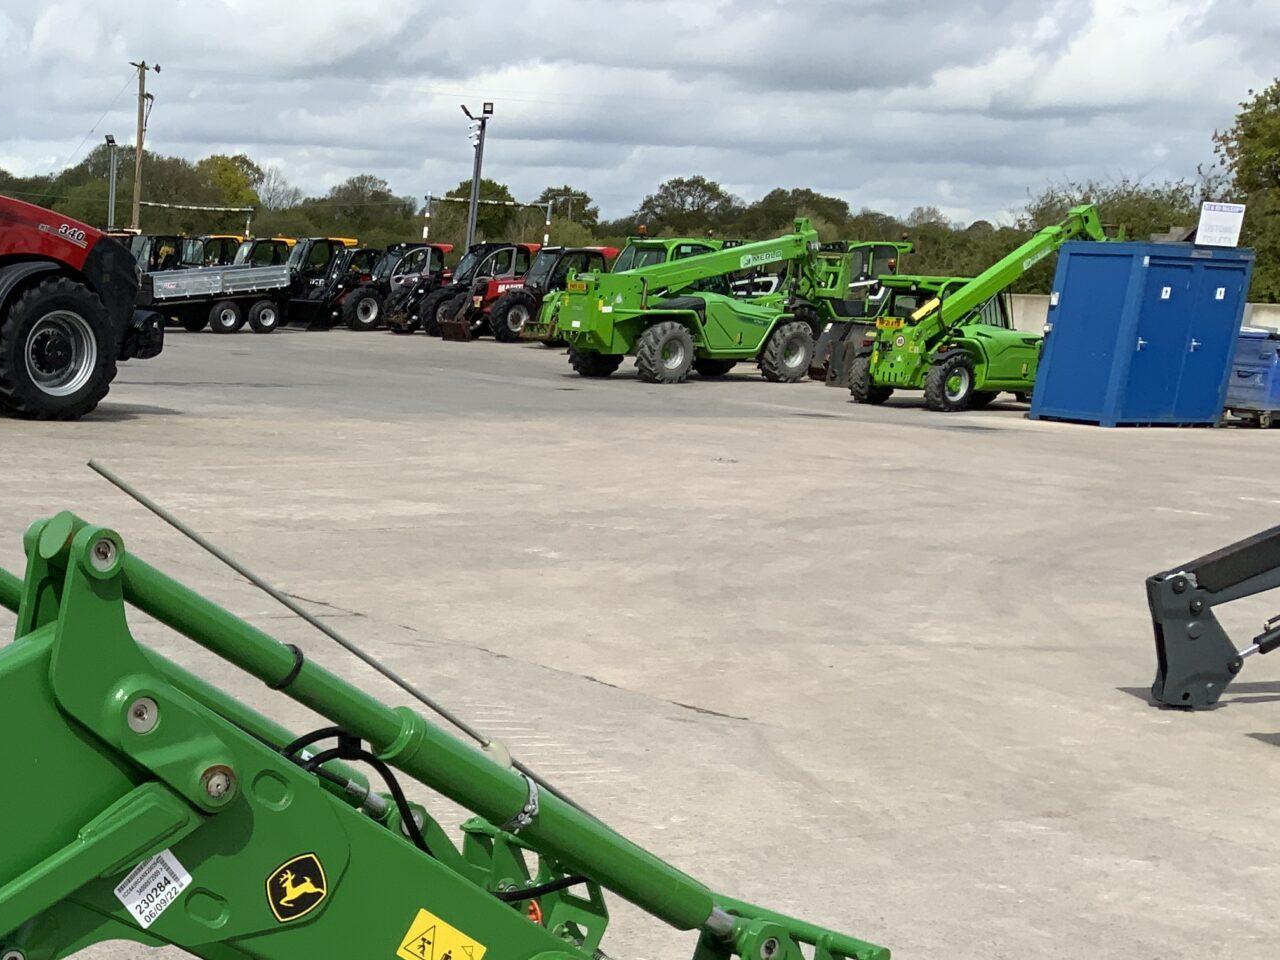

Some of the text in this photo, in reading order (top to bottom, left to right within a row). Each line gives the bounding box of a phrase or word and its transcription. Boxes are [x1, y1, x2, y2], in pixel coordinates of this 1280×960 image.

[58, 223, 86, 241] 340
[135, 876, 171, 915] 230284
[144, 886, 179, 924] 06/09/22
